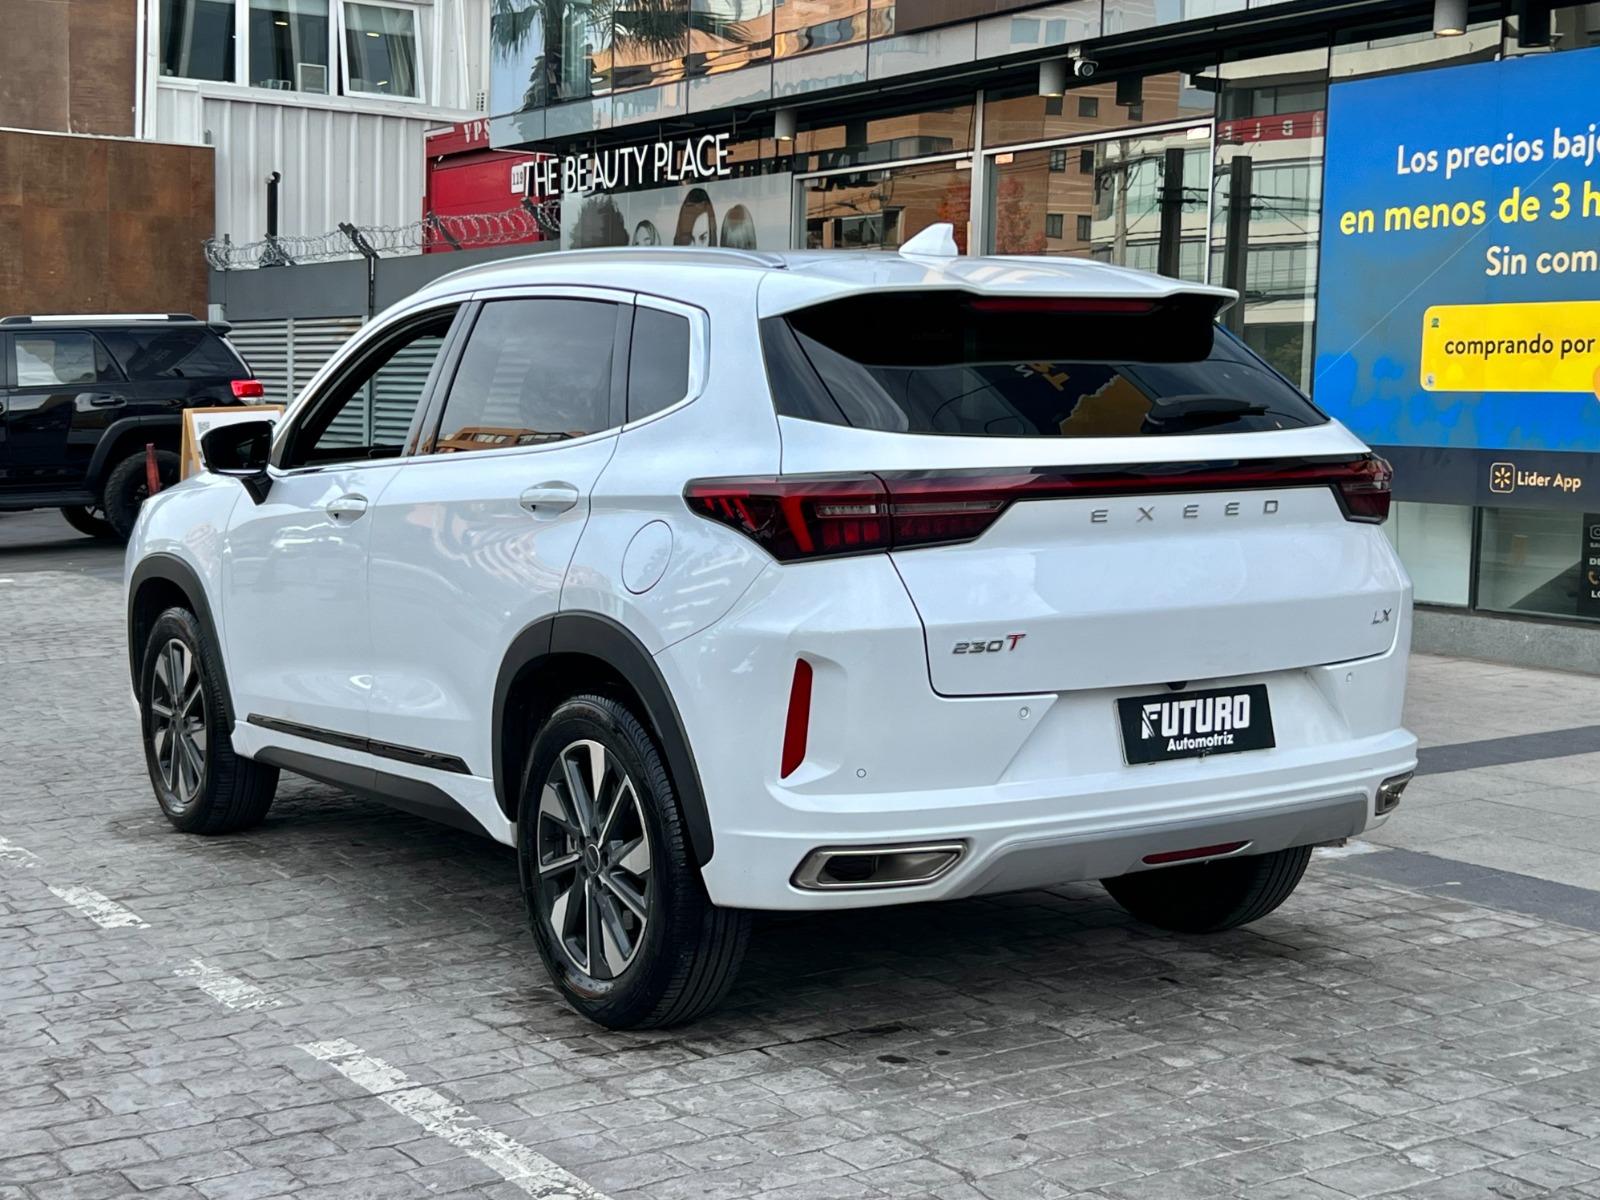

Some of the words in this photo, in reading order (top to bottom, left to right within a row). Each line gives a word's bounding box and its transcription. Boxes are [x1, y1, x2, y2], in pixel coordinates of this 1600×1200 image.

[1396, 144, 1438, 175] Los
[1445, 133, 1543, 179] precios
[1552, 123, 1600, 166] baj
[522, 158, 559, 197] THE
[565, 145, 648, 192] BEAUTY
[654, 133, 731, 182] PLACE
[1340, 209, 1374, 235] en
[1384, 200, 1486, 231] menos
[1499, 187, 1540, 223] de
[1550, 182, 1571, 220] 3
[1485, 246, 1527, 276] Sin
[1444, 333, 1553, 360] comprando
[1560, 338, 1596, 360] por
[1517, 471, 1551, 486] Lider
[1553, 473, 1581, 492] App
[1090, 500, 1278, 523] EXEED
[1371, 608, 1392, 625] LX
[952, 633, 1026, 655] 230T
[1141, 694, 1250, 740] FUTURO
[1167, 731, 1234, 752] Automotriz
